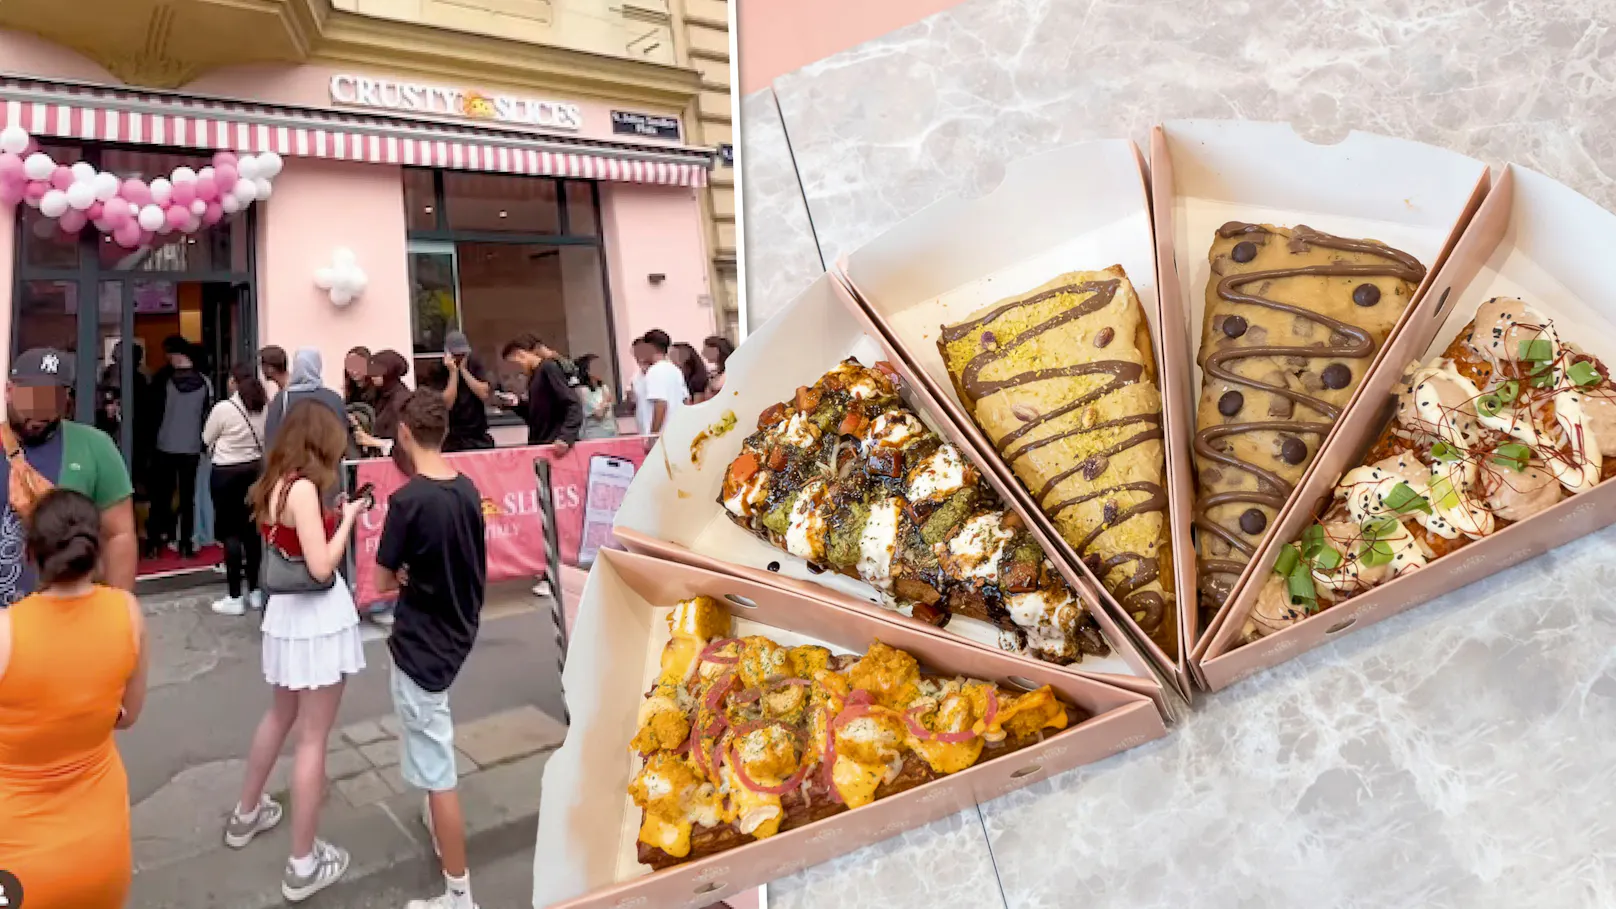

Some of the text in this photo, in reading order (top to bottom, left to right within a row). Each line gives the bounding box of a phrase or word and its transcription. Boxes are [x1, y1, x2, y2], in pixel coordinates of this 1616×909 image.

[330, 73, 464, 114] CRUSTY
[494, 96, 582, 130] SLICES
[503, 483, 580, 516] SLIES
